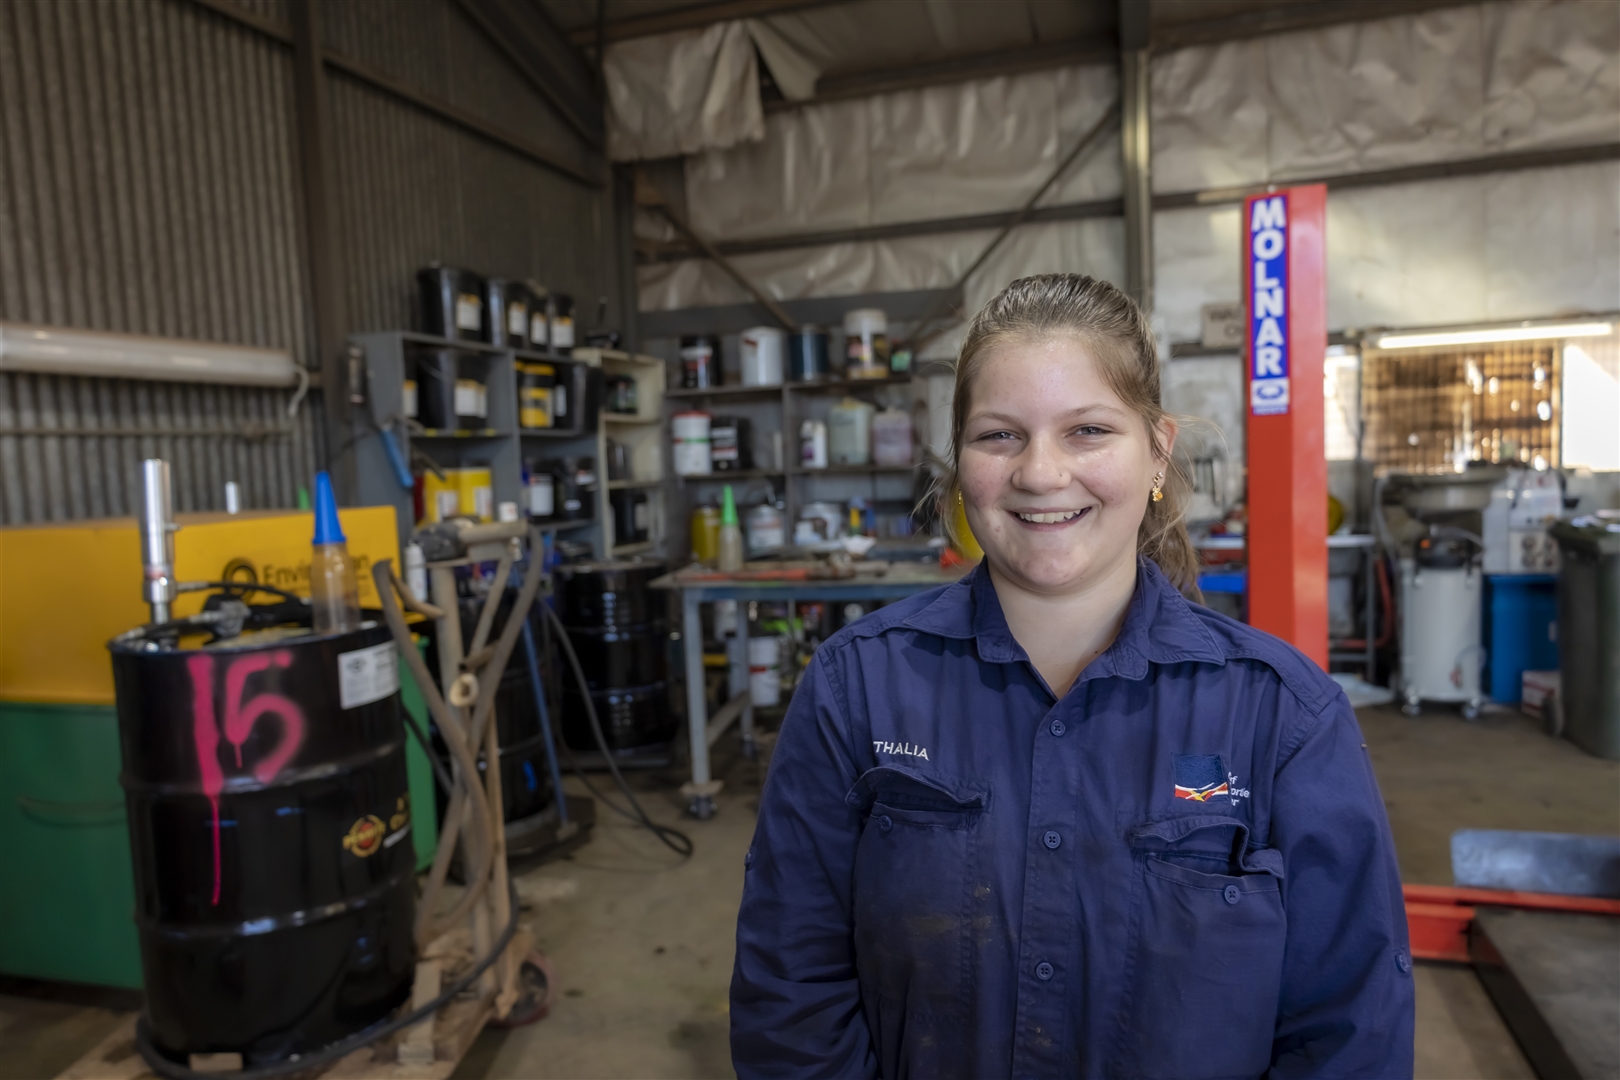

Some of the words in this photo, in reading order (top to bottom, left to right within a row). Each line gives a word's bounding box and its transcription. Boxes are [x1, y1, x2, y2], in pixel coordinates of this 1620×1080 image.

[1250, 196, 1287, 376] MOLNAR
[186, 650, 306, 800] 15
[873, 741, 930, 761] THALIA
